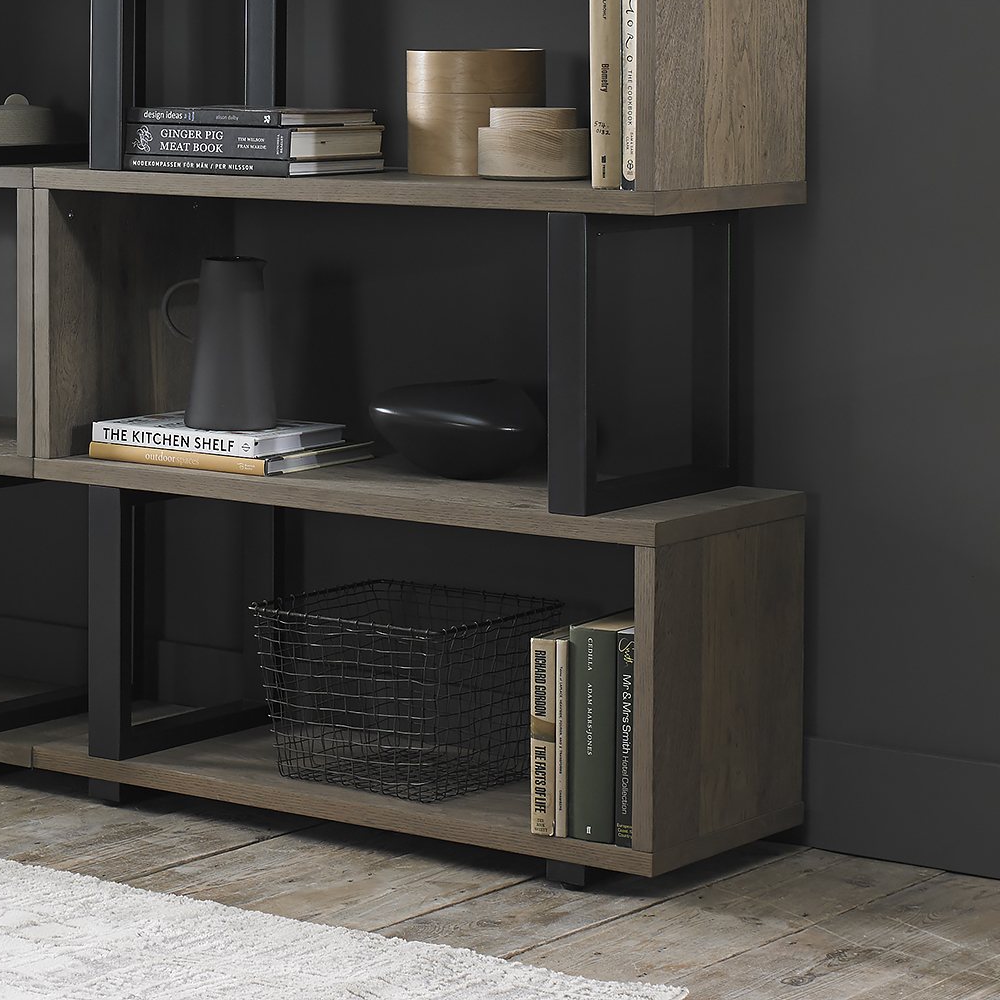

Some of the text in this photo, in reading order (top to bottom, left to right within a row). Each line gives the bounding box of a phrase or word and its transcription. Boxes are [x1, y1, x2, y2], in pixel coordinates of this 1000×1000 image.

[601, 63, 610, 93] Biometry
[143, 110, 183, 120] design ideas
[160, 129, 224, 141] GINGER PIG
[159, 142, 223, 153] MEAT BOOK
[132, 159, 181, 169] MODEKOMPASSEN
[215, 162, 227, 170] PER
[228, 163, 254, 171] NILSSON
[103, 427, 235, 452] THE KITCHEN SHELF
[534, 650, 546, 717] RICHARD GORDON
[623, 674, 631, 690] Mr
[623, 691, 632, 701] &
[623, 702, 631, 723] Mrs
[622, 724, 631, 754] Smith
[534, 746, 546, 760] THE
[534, 762, 546, 785] FACTS
[534, 787, 546, 797] OF
[534, 797, 546, 813] LIFE
